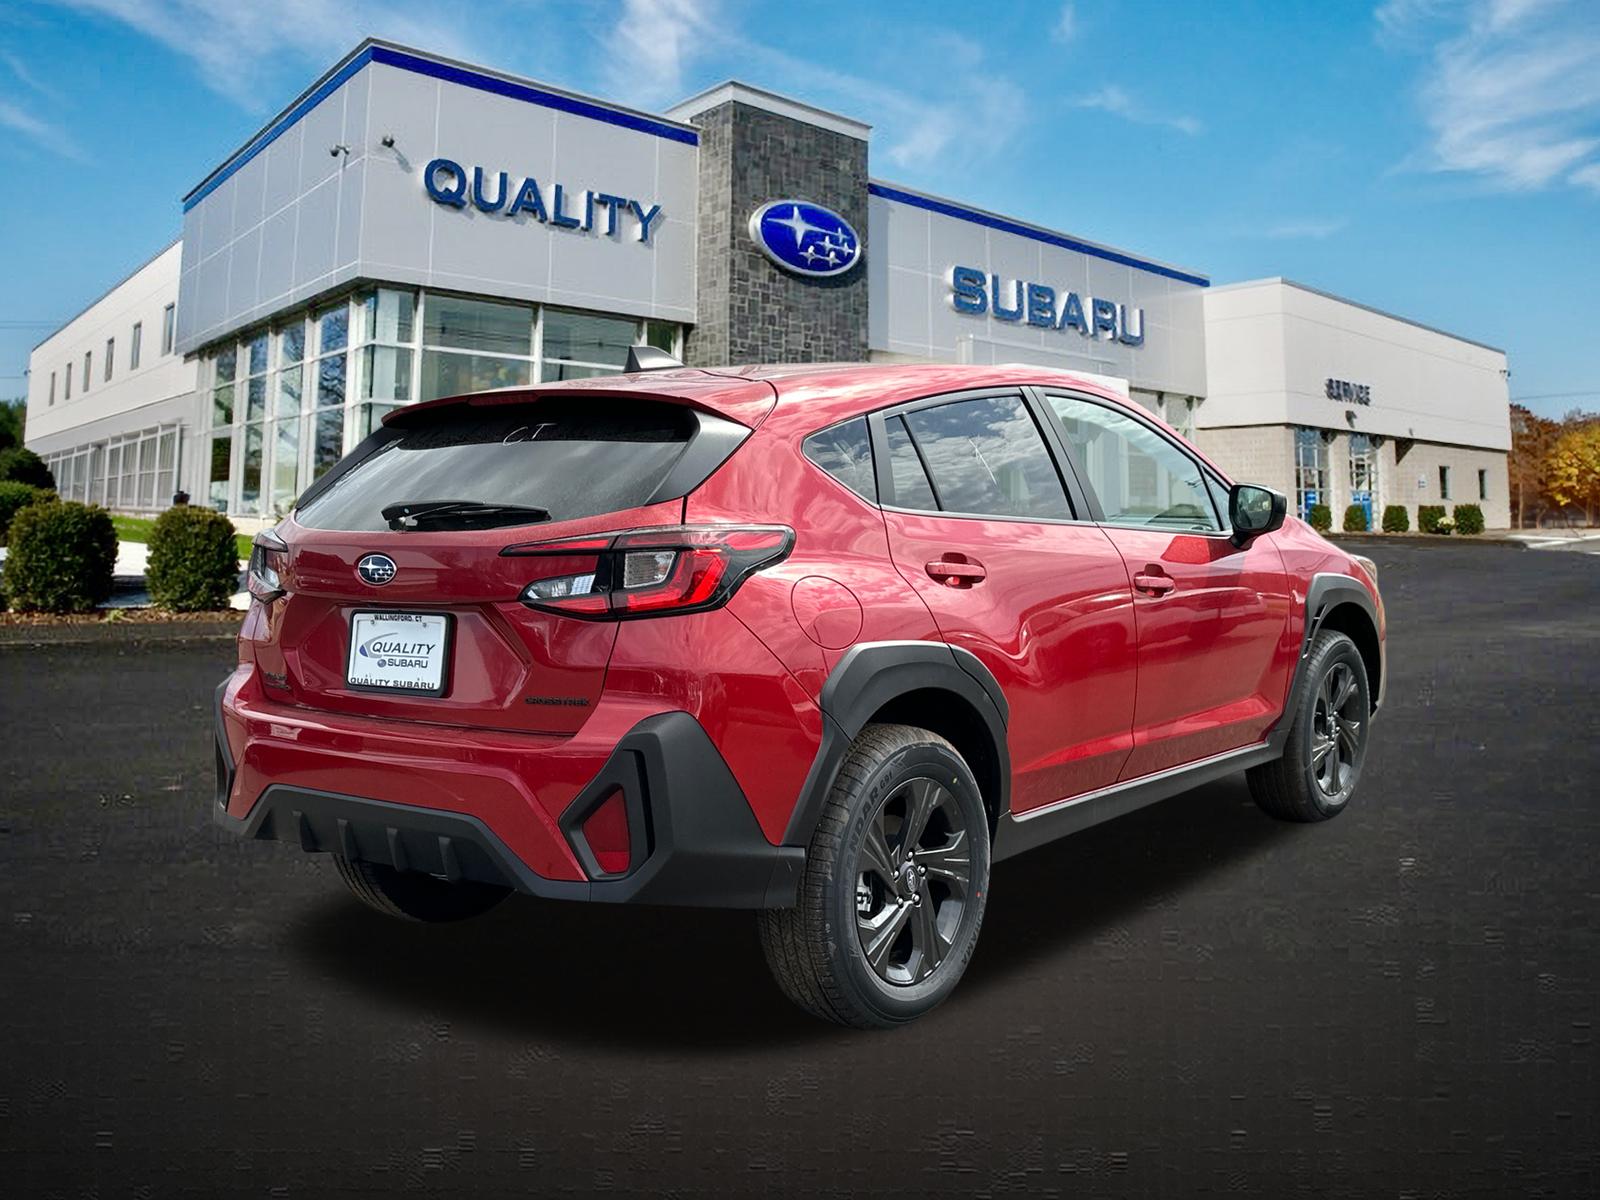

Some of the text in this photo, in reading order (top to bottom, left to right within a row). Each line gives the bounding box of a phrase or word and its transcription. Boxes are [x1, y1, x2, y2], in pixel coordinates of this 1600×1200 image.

[424, 157, 661, 243] QUALITY
[946, 264, 1145, 346] SUBARU
[415, 615, 423, 623] CT
[372, 641, 436, 655] QUALITY
[387, 658, 429, 669] SUBARU
[350, 677, 435, 690] QUALITY SUBARU
